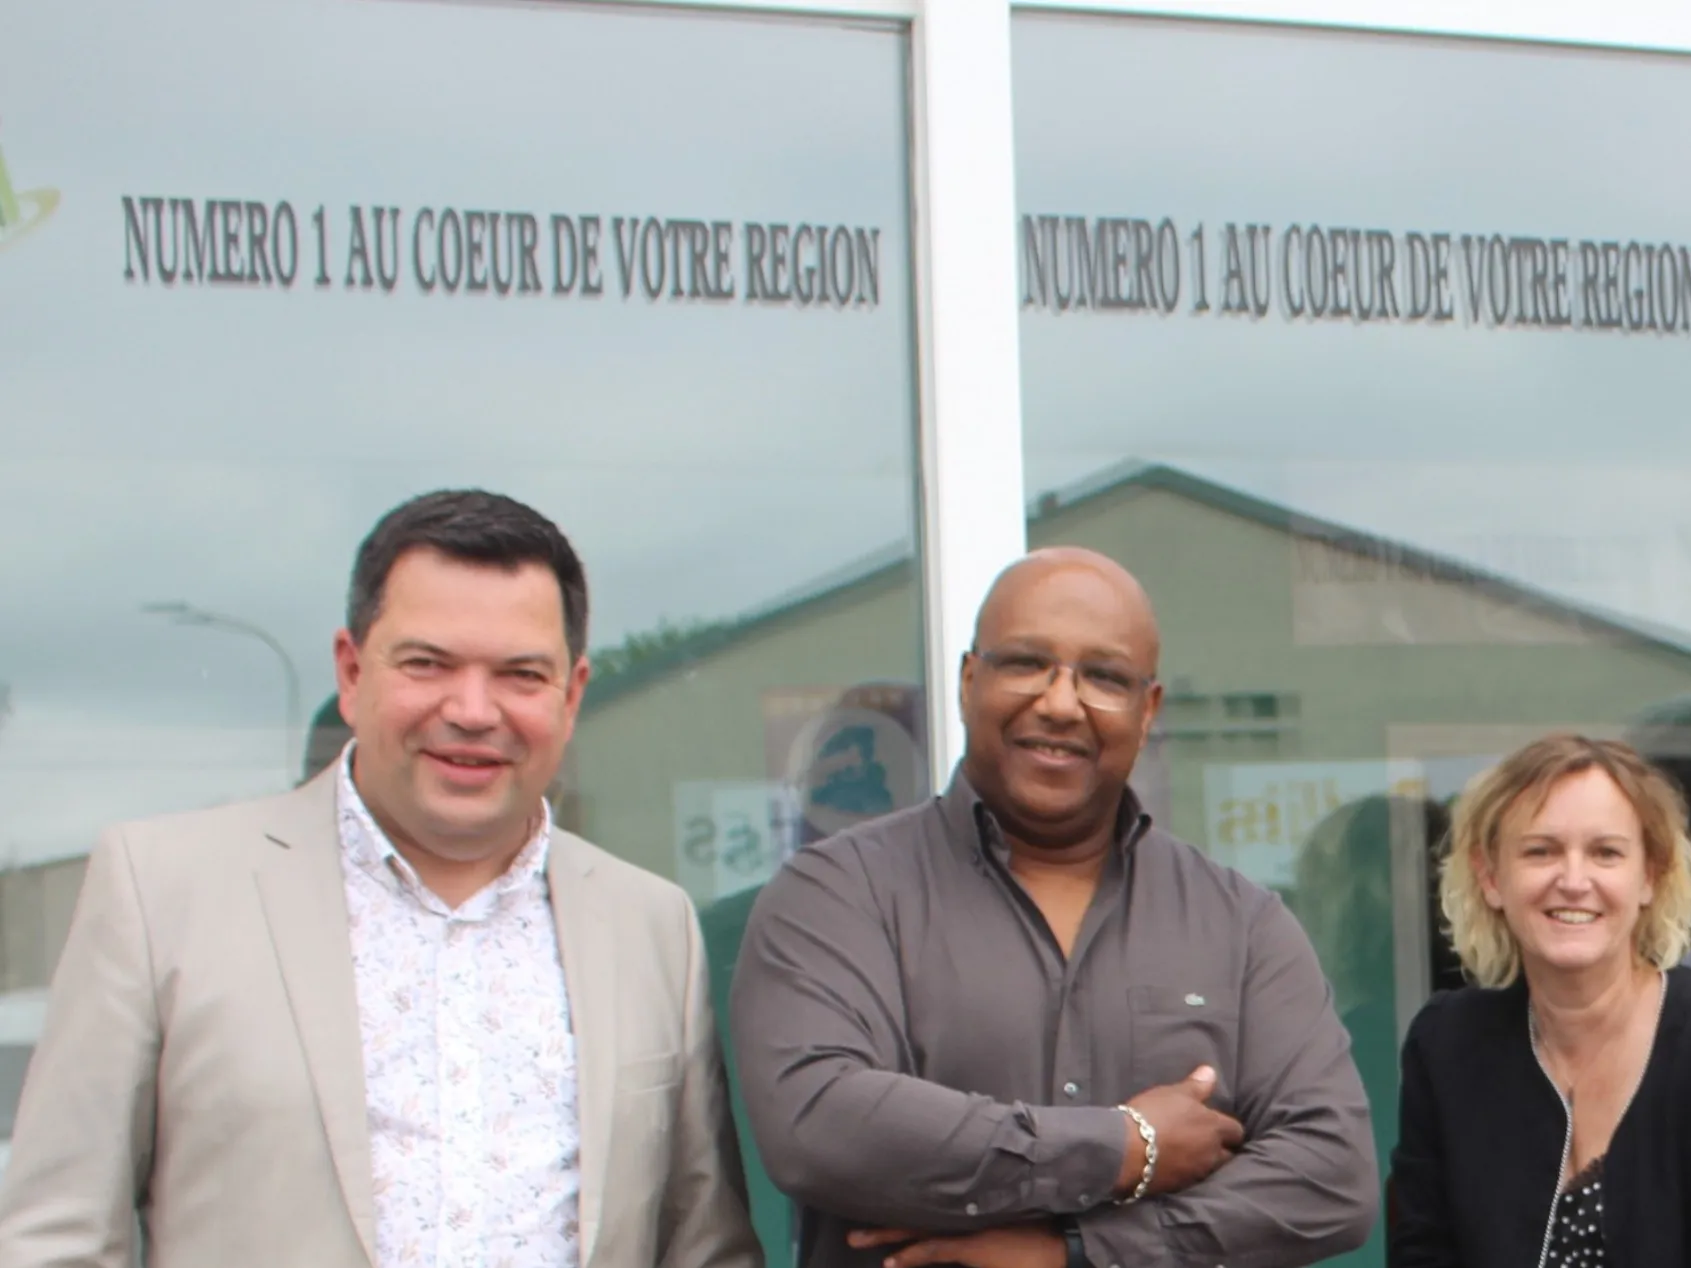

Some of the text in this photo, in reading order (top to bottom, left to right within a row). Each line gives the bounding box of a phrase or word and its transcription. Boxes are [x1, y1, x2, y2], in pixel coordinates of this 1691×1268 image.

[122, 195, 882, 307] NUMERO 1 AU COEUR DE VOTRE REGION
[1021, 214, 1181, 313] NUMERO
[1190, 226, 1211, 314] 1
[1221, 222, 1273, 316] AU
[1282, 223, 1399, 321] COEUR
[1407, 230, 1454, 324] DE
[1459, 235, 1572, 330] VOTRE
